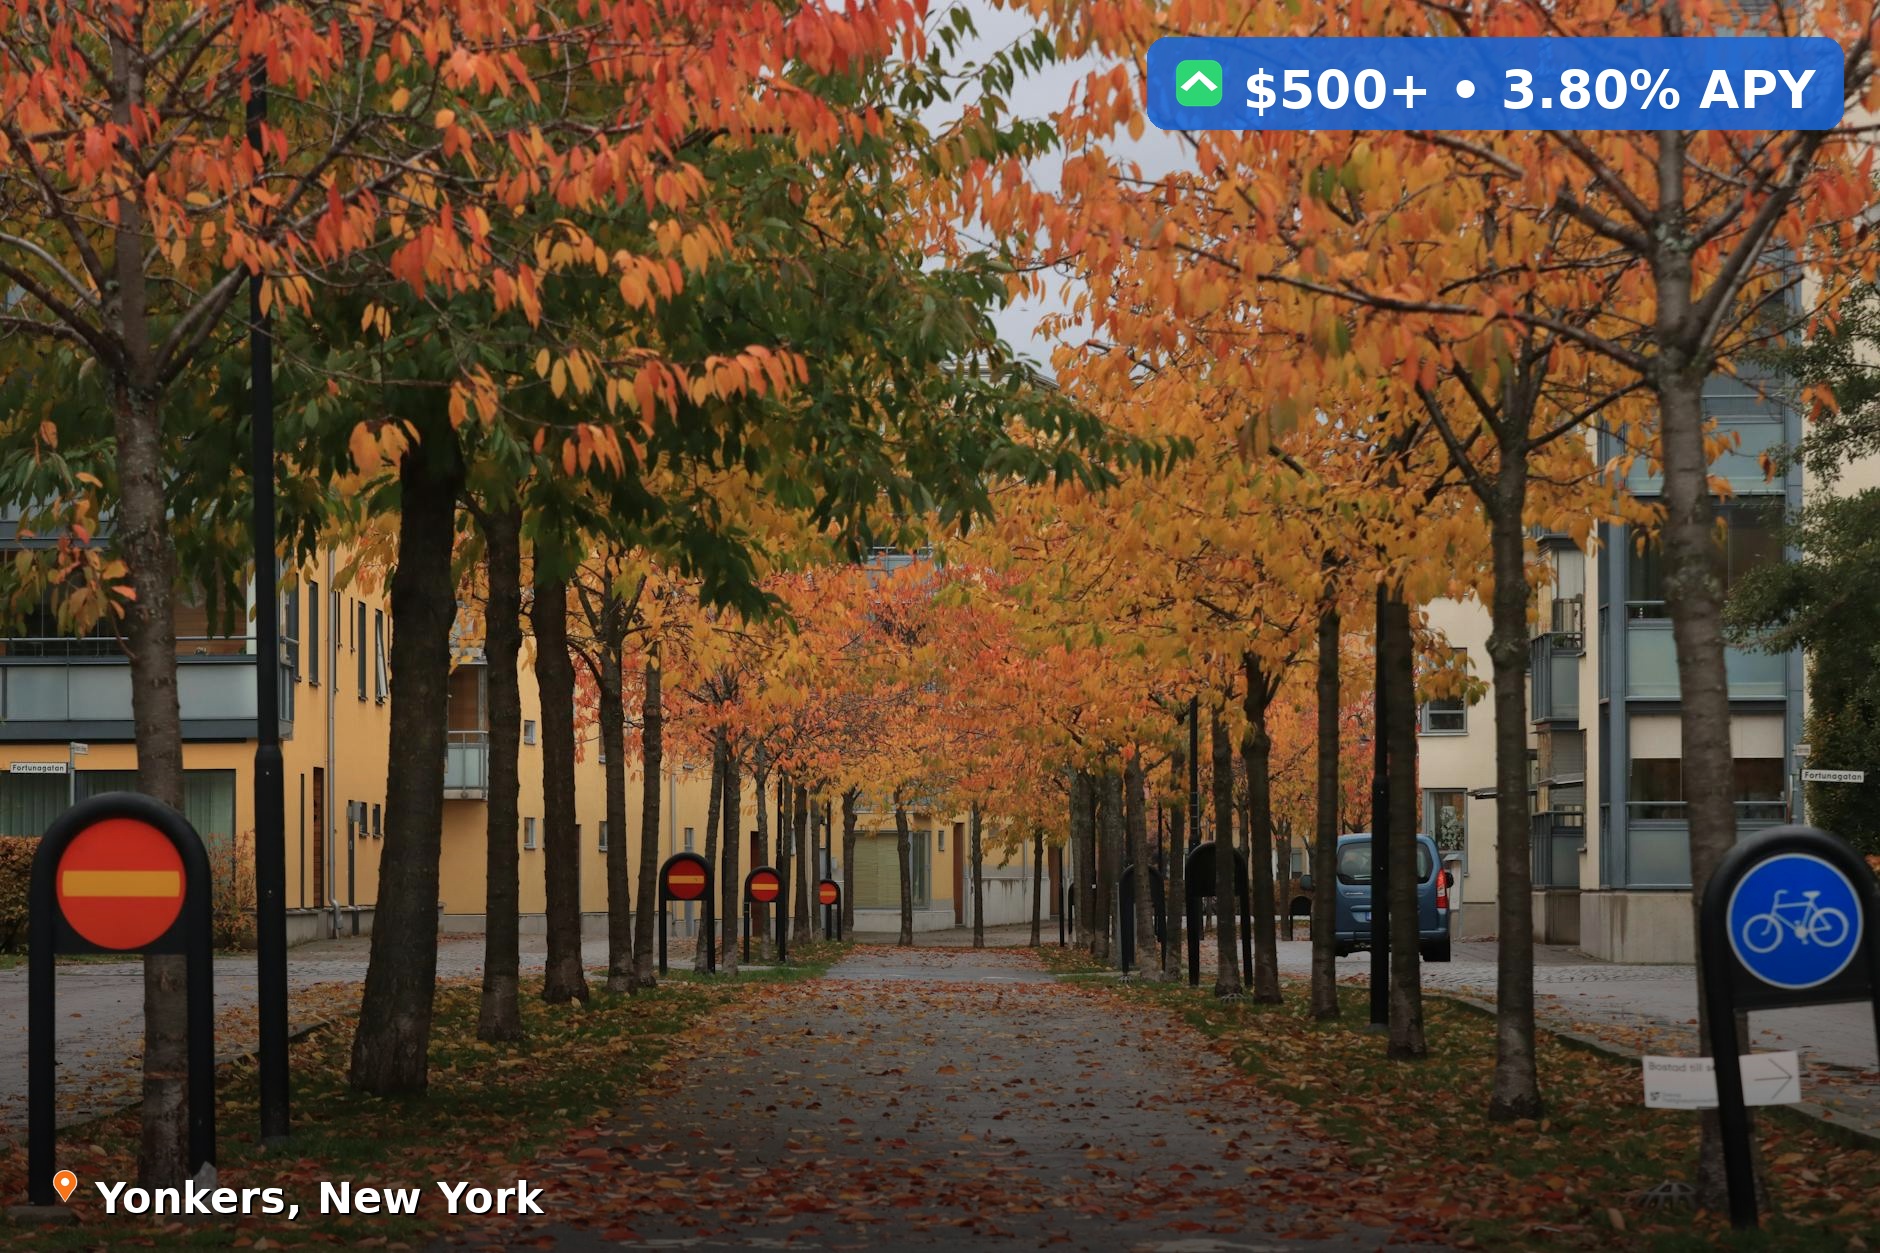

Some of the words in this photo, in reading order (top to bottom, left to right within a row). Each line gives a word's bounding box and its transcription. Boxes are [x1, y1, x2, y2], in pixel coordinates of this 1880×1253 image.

[12, 764, 64, 773] Fortunagatan
[1804, 771, 1862, 781] Fortunagatan
[1648, 1061, 1686, 1072] Bostad
[1690, 1062, 1702, 1072] till
